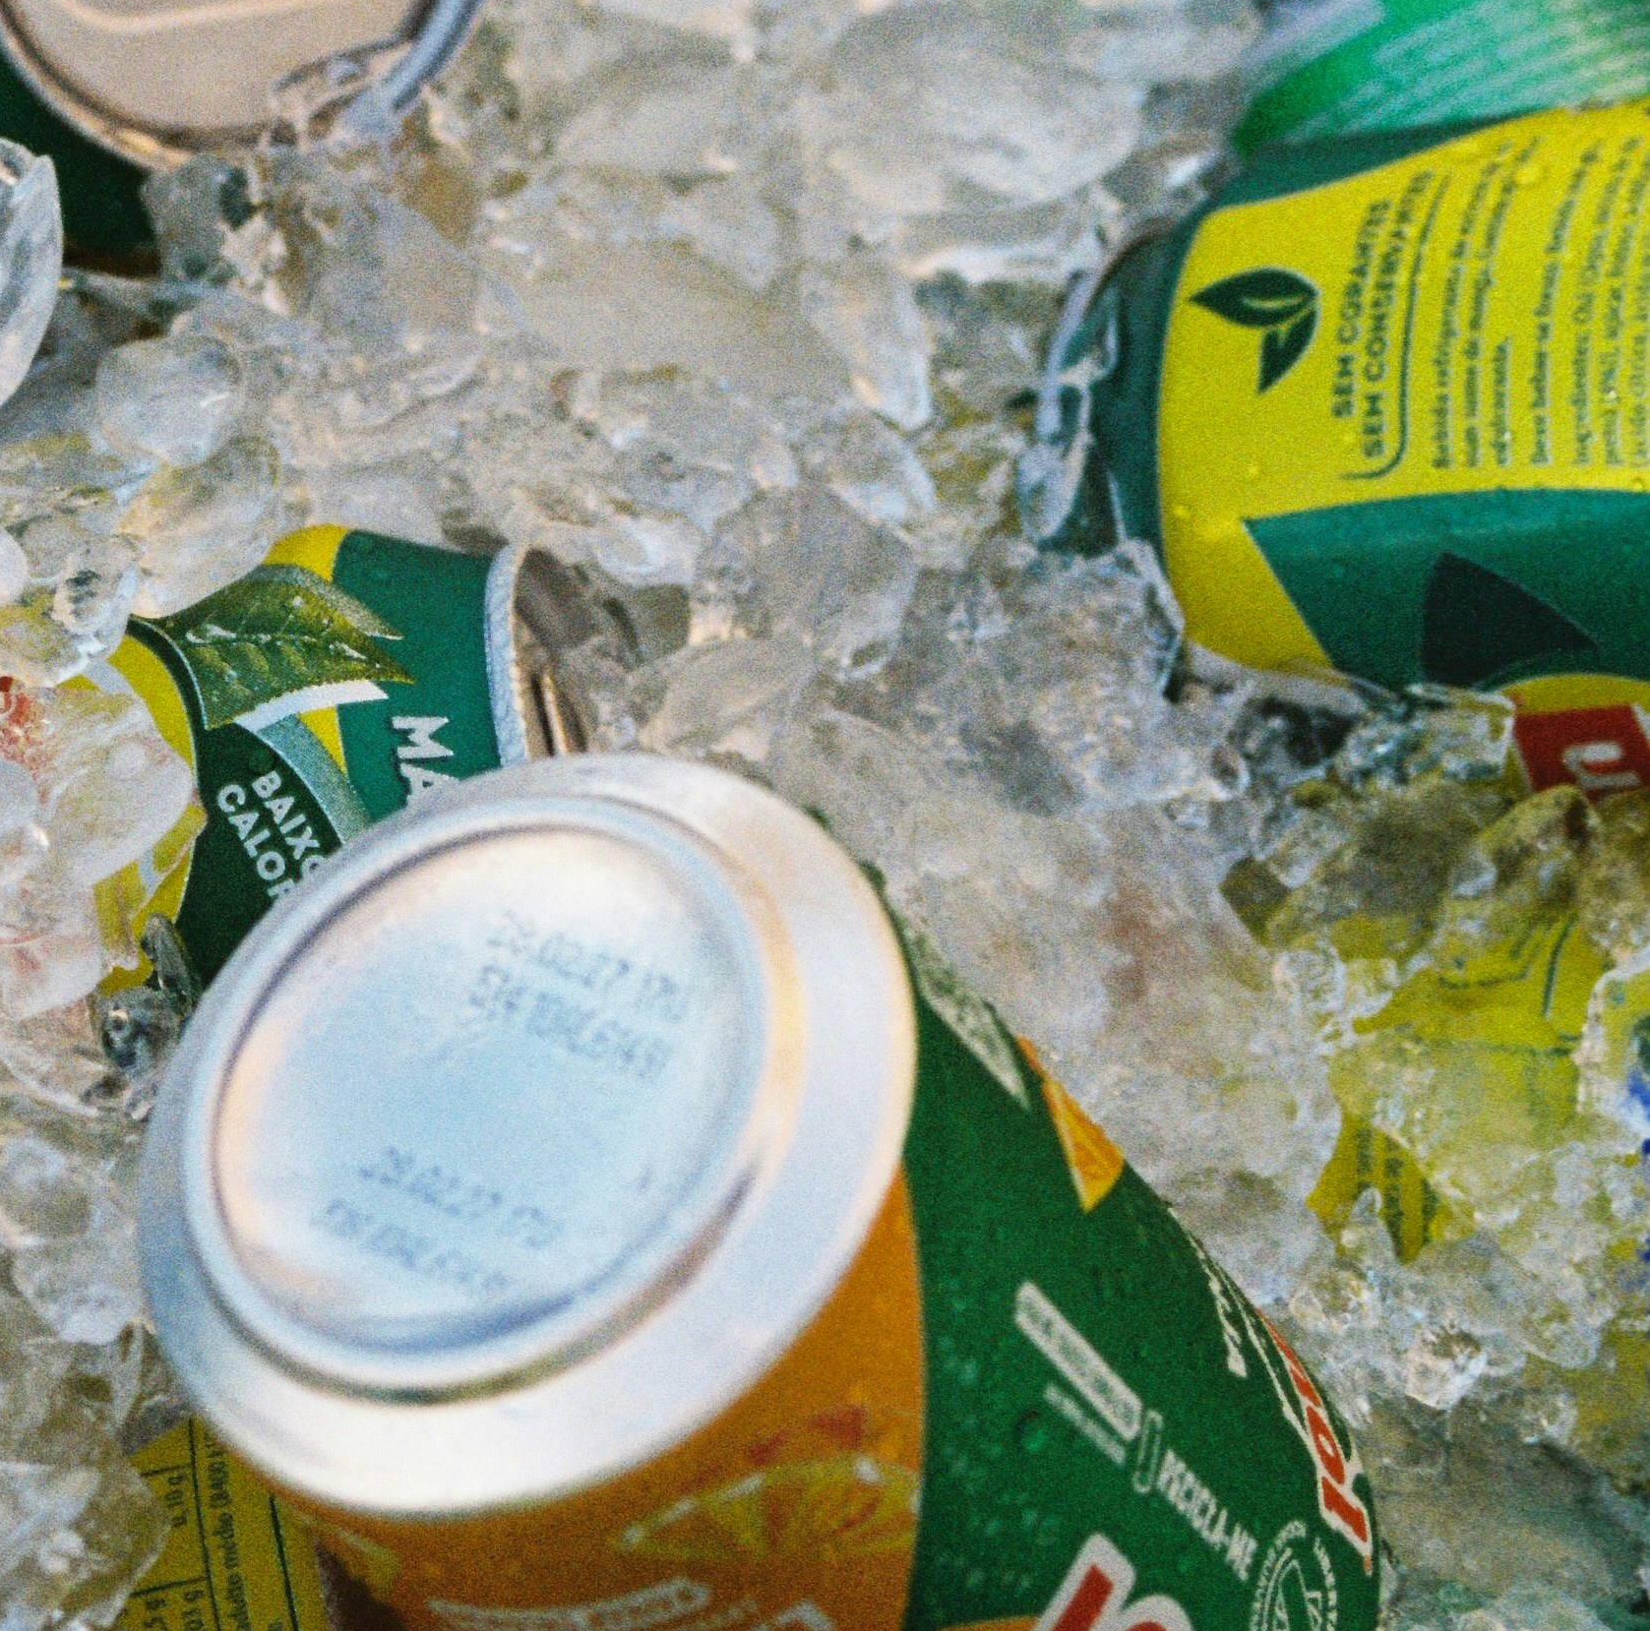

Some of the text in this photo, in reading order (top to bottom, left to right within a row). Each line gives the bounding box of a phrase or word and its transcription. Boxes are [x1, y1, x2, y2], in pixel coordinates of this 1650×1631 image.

[1332, 360, 1357, 420] SEM
[1358, 389, 1386, 460] SEM
[215, 782, 290, 899] CALOR
